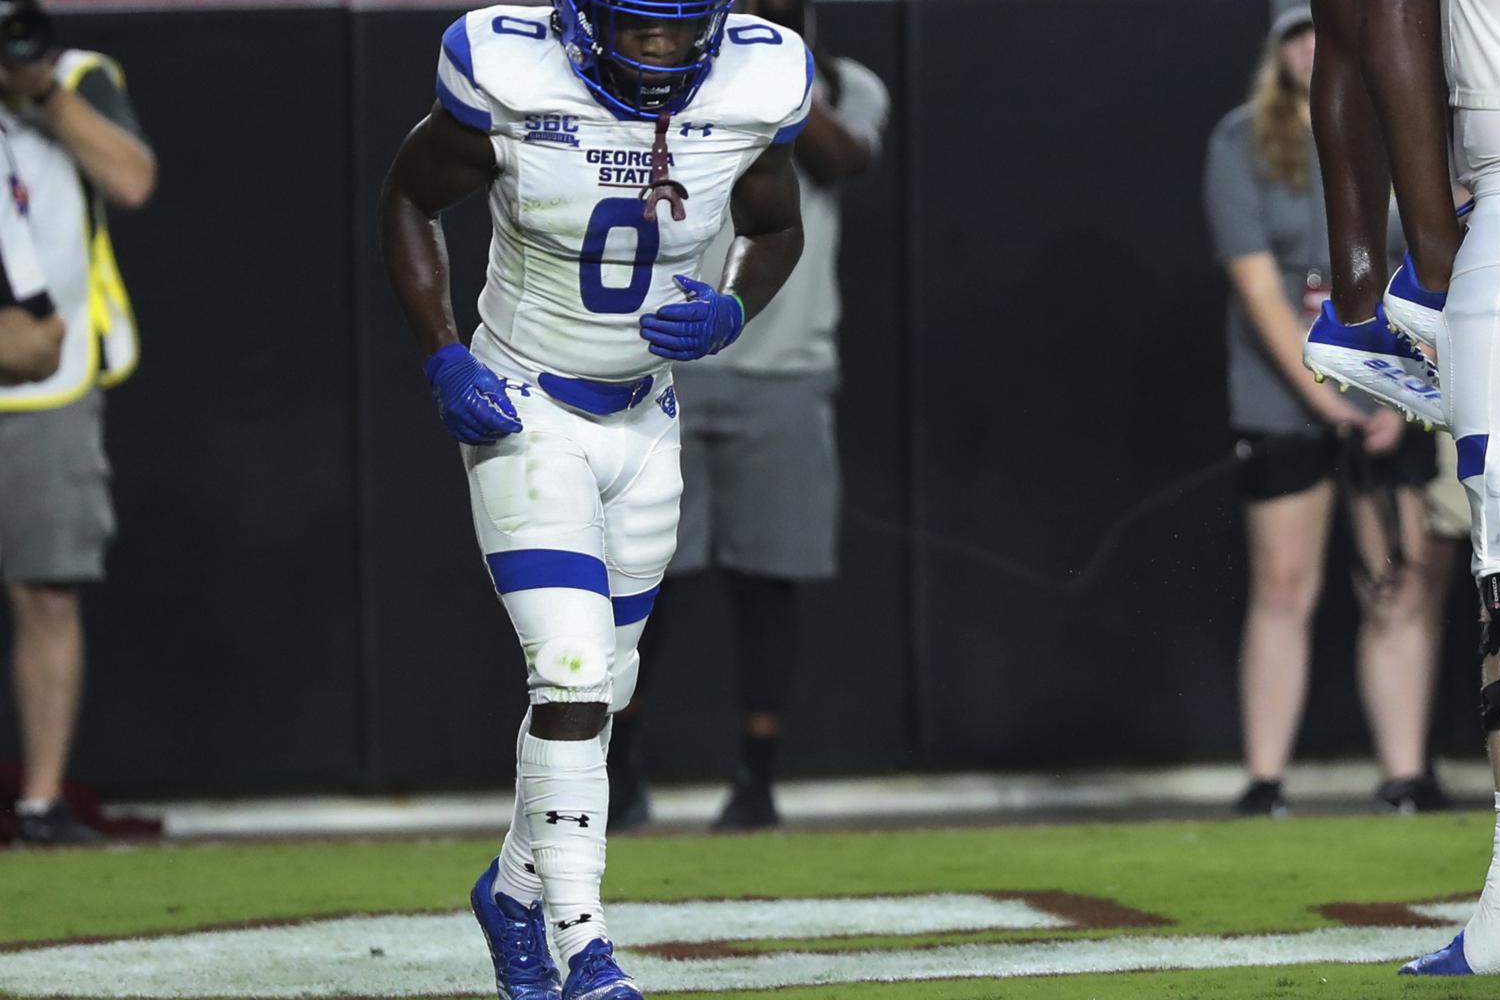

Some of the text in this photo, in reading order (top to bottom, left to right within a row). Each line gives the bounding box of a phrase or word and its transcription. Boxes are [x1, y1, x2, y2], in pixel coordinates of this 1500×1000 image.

[492, 15, 547, 40] 0
[726, 23, 783, 46] 0
[524, 114, 580, 132] SBC
[585, 149, 676, 168] GEORGA
[578, 196, 661, 315] 0
